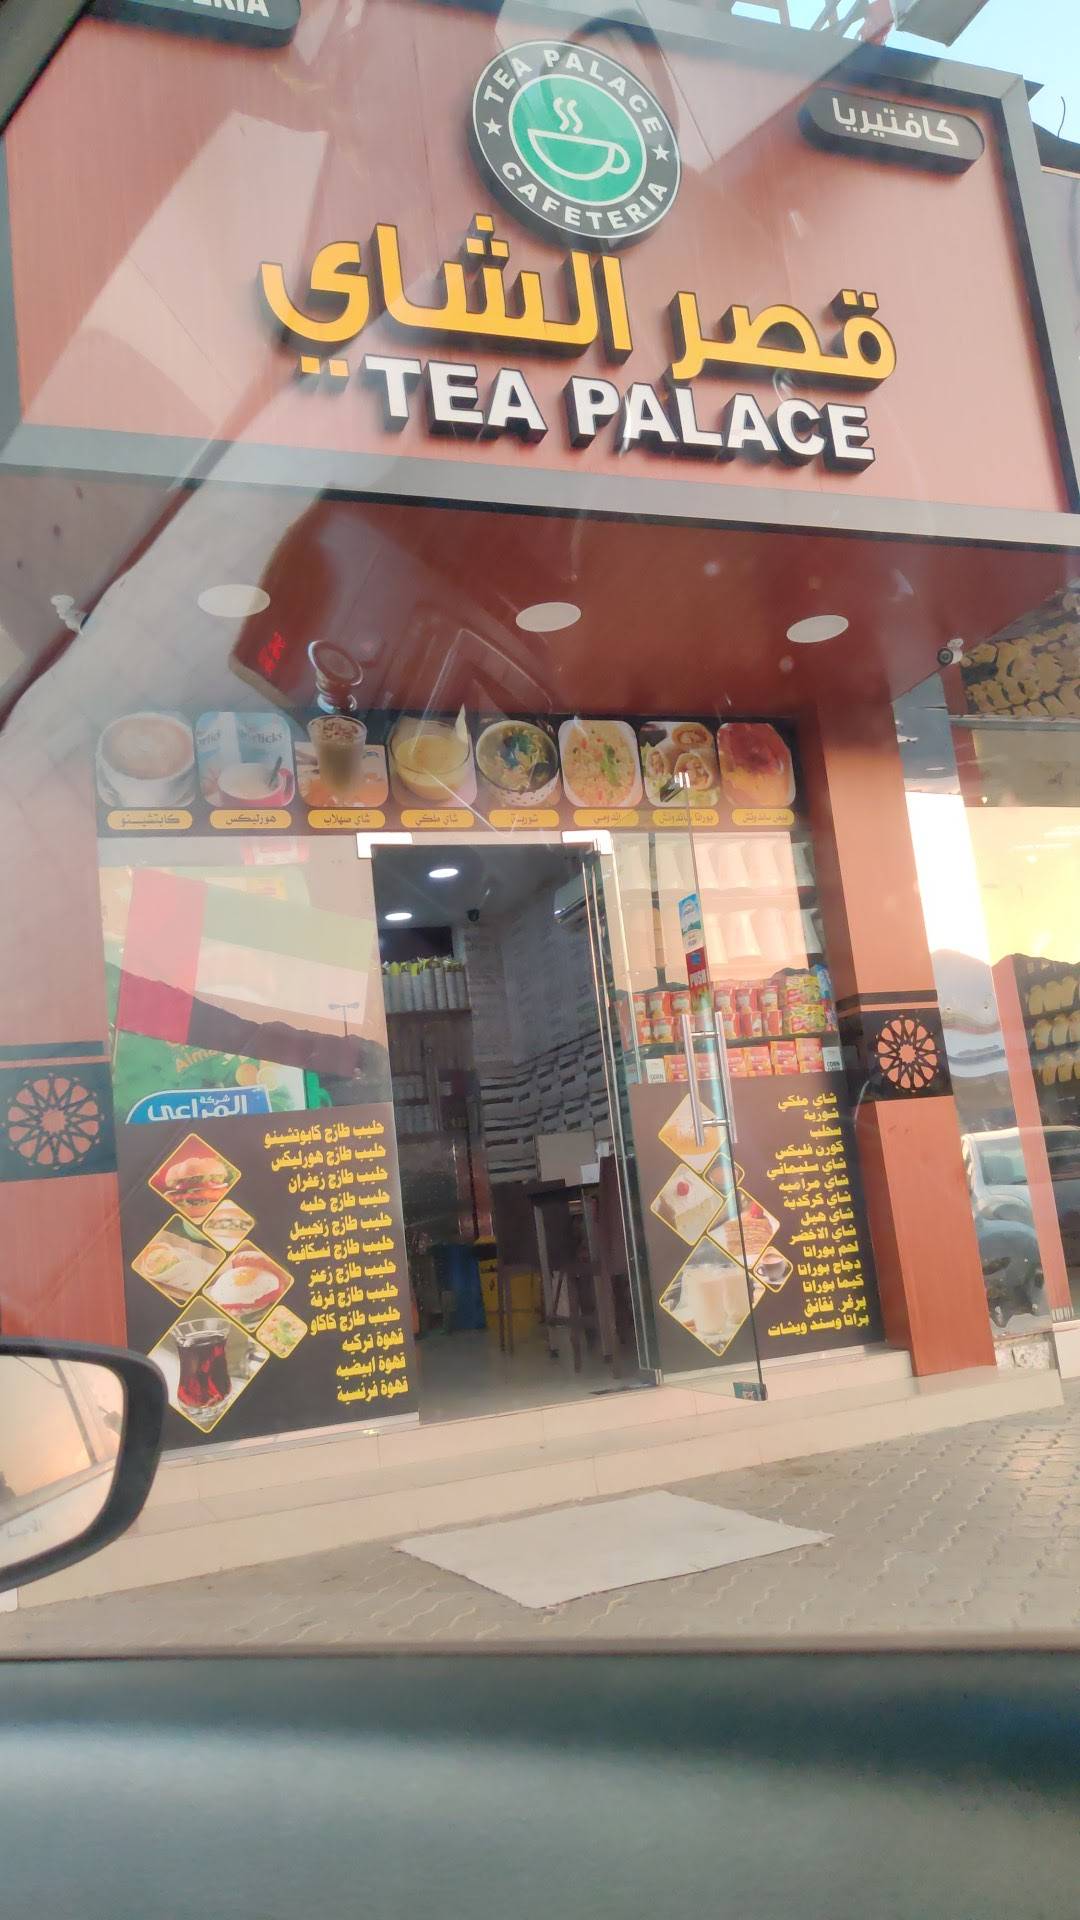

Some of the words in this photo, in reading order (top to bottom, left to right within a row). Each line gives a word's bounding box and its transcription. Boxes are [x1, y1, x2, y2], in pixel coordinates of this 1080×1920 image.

[484, 57, 532, 104] TEA
[544, 49, 663, 134] PALACE
[832, 97, 960, 147] كافتيريا
[502, 162, 668, 231] CAFETERIA
[260, 214, 633, 377] الشاي
[671, 289, 897, 380] قصر
[364, 353, 548, 431] TEA
[571, 376, 876, 461] PALACE
[354, 813, 371, 826] شاي
[443, 813, 458, 826] شاي
[778, 1095, 808, 1112] ملكي
[812, 1092, 837, 1109] شاي
[263, 1124, 322, 1148] كابوتشينو
[325, 1123, 350, 1143] طازج
[353, 1120, 384, 1139] حليب
[810, 1124, 841, 1140] سحلب
[326, 1146, 352, 1166] طازج
[355, 1142, 386, 1161] حليب
[775, 1143, 813, 1160] فليكس
[816, 1140, 844, 1156] كورن
[271, 1149, 324, 1172] هورليكس
[767, 1161, 819, 1180] سليماني
[822, 1158, 846, 1175] شاي
[288, 1172, 326, 1194] زعفران
[328, 1168, 354, 1189] طازج
[356, 1166, 388, 1184] حليب
[824, 1174, 849, 1191] شاي
[330, 1191, 356, 1212] طازج
[358, 1189, 390, 1208] حليب
[826, 1190, 852, 1208] شاي
[332, 1214, 357, 1236] طازج
[361, 1212, 392, 1232] حليب
[800, 1211, 826, 1226] هيل
[829, 1207, 854, 1225] شاي
[289, 1218, 329, 1241] زنجبيل
[789, 1226, 828, 1246] الاخضر
[831, 1224, 856, 1242] شاي
[333, 1238, 360, 1260] طازج
[363, 1235, 394, 1255] حليب
[838, 1240, 859, 1257] لحم
[335, 1262, 361, 1284] طازج
[364, 1258, 396, 1279] حليب
[833, 1259, 861, 1274] دجاج
[837, 1274, 864, 1289] كيما
[310, 1289, 335, 1310] قرفة
[338, 1286, 364, 1308] طازج
[367, 1282, 398, 1302] حليب
[368, 1306, 400, 1326] حليب
[804, 1296, 834, 1318] نقانق
[310, 1313, 337, 1336] كاكاو
[339, 1310, 365, 1332] طازج
[376, 1328, 404, 1350] قهوة
[379, 1352, 406, 1374] قهوة
[337, 1381, 378, 1405] فرنسية
[380, 1376, 408, 1398] قهوة
